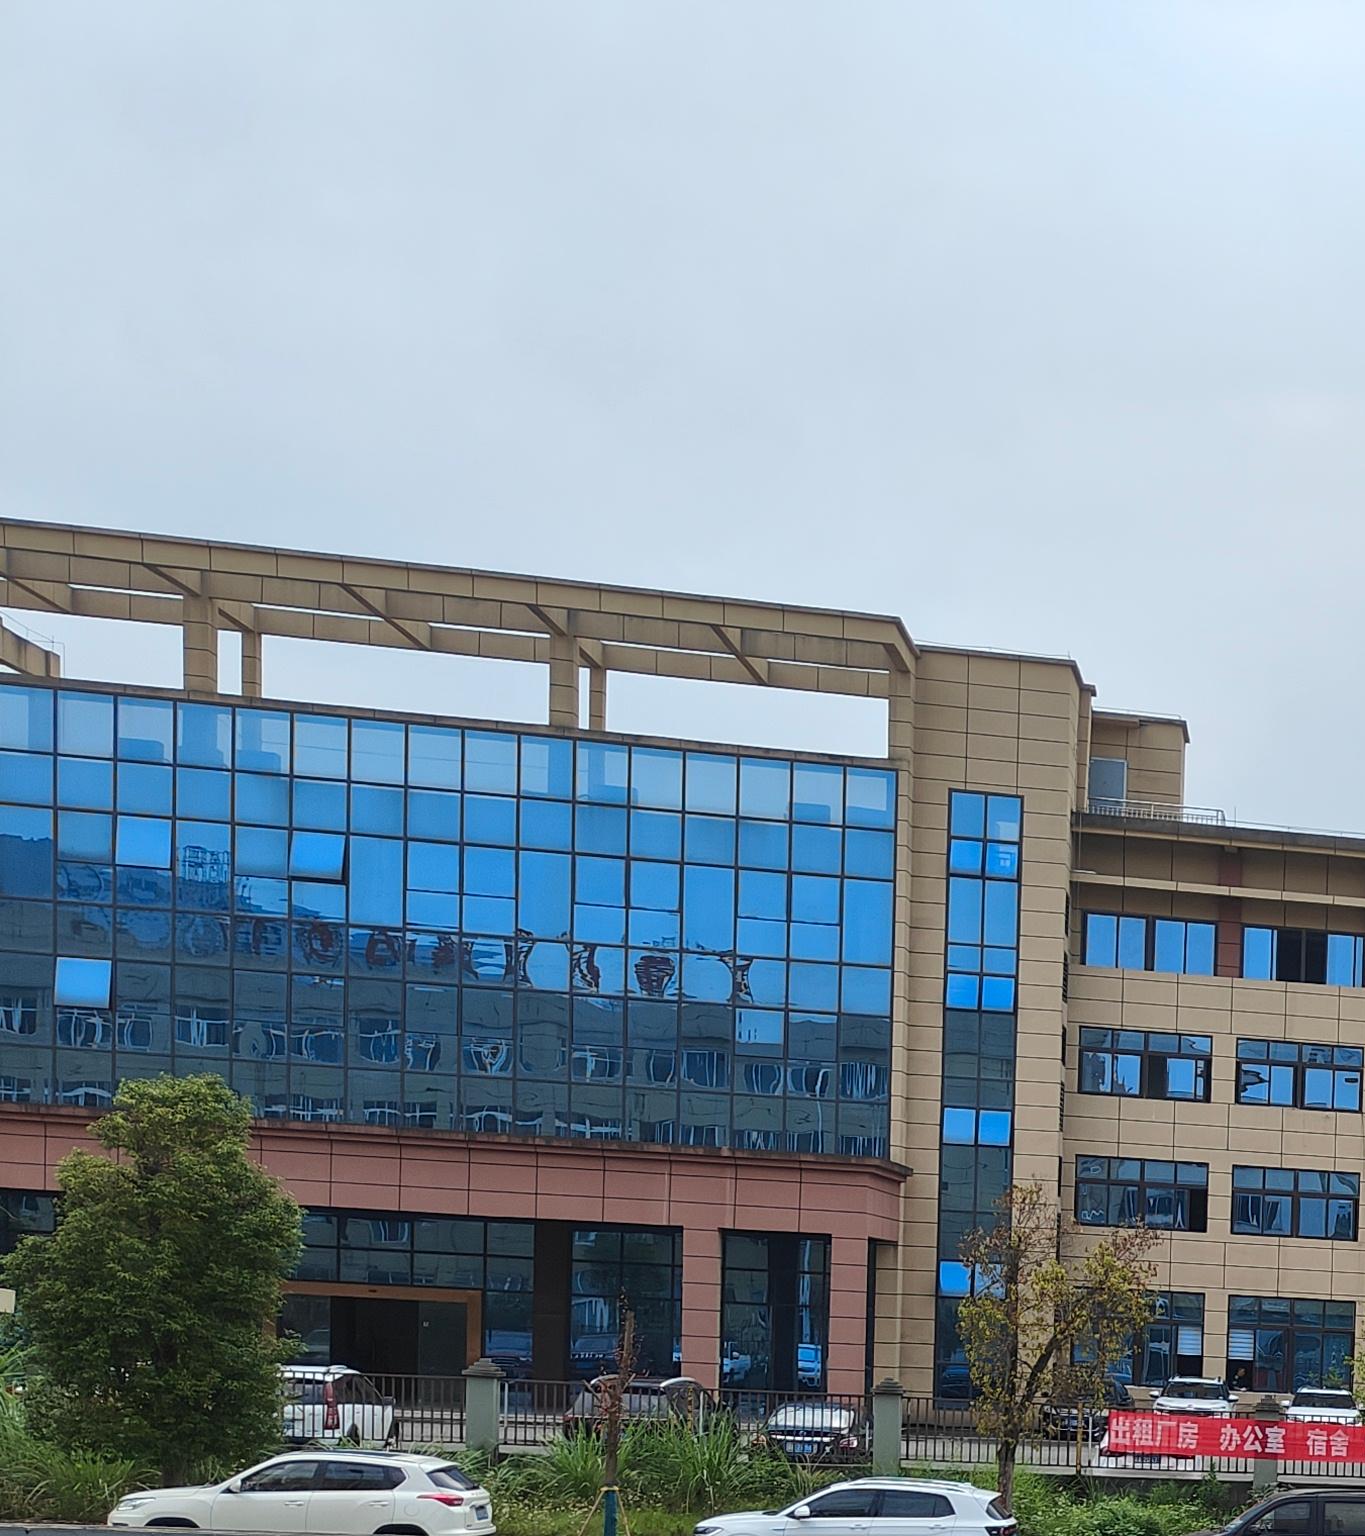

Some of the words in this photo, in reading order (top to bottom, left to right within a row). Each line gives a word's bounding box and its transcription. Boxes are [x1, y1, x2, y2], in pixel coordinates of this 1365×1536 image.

[1109, 1415, 1199, 1449] 出租厂房
[1219, 1423, 1286, 1455] 办公室
[1306, 1428, 1349, 1457] 宿舍
